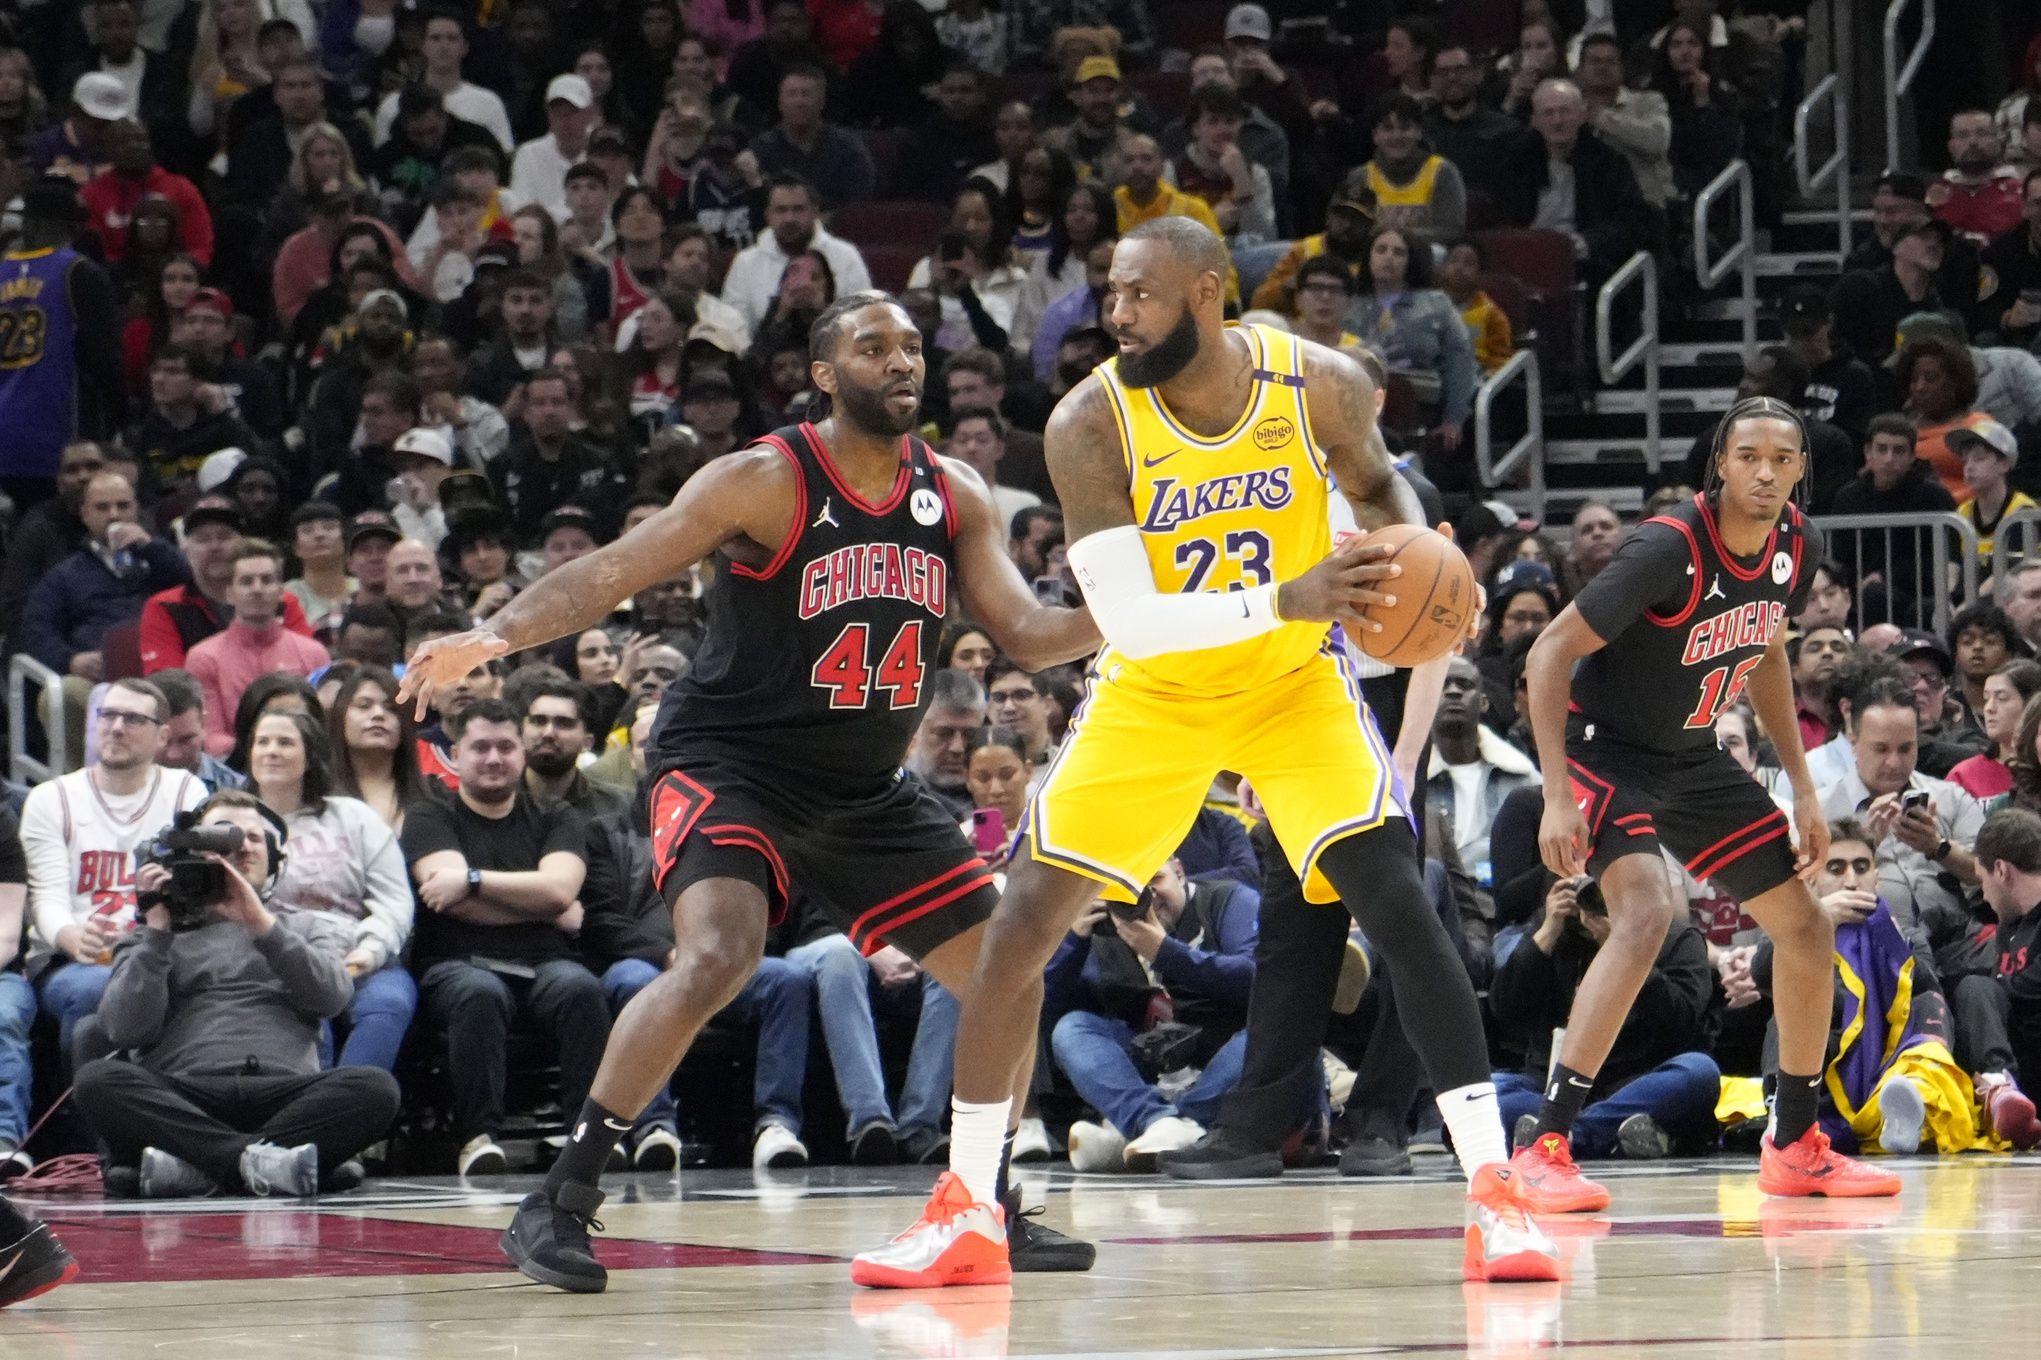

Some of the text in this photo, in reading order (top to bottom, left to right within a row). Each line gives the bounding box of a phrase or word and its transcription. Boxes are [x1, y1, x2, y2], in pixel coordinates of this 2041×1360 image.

[1256, 426, 1292, 440] bibigo
[1139, 466, 1293, 534] LAKERS
[798, 542, 946, 621] CHICAGO
[1174, 530, 1273, 593] 23
[810, 619, 926, 711] 44
[1681, 600, 1786, 666] CHICAG
[1683, 653, 1765, 730] 15
[78, 850, 137, 895] BUL
